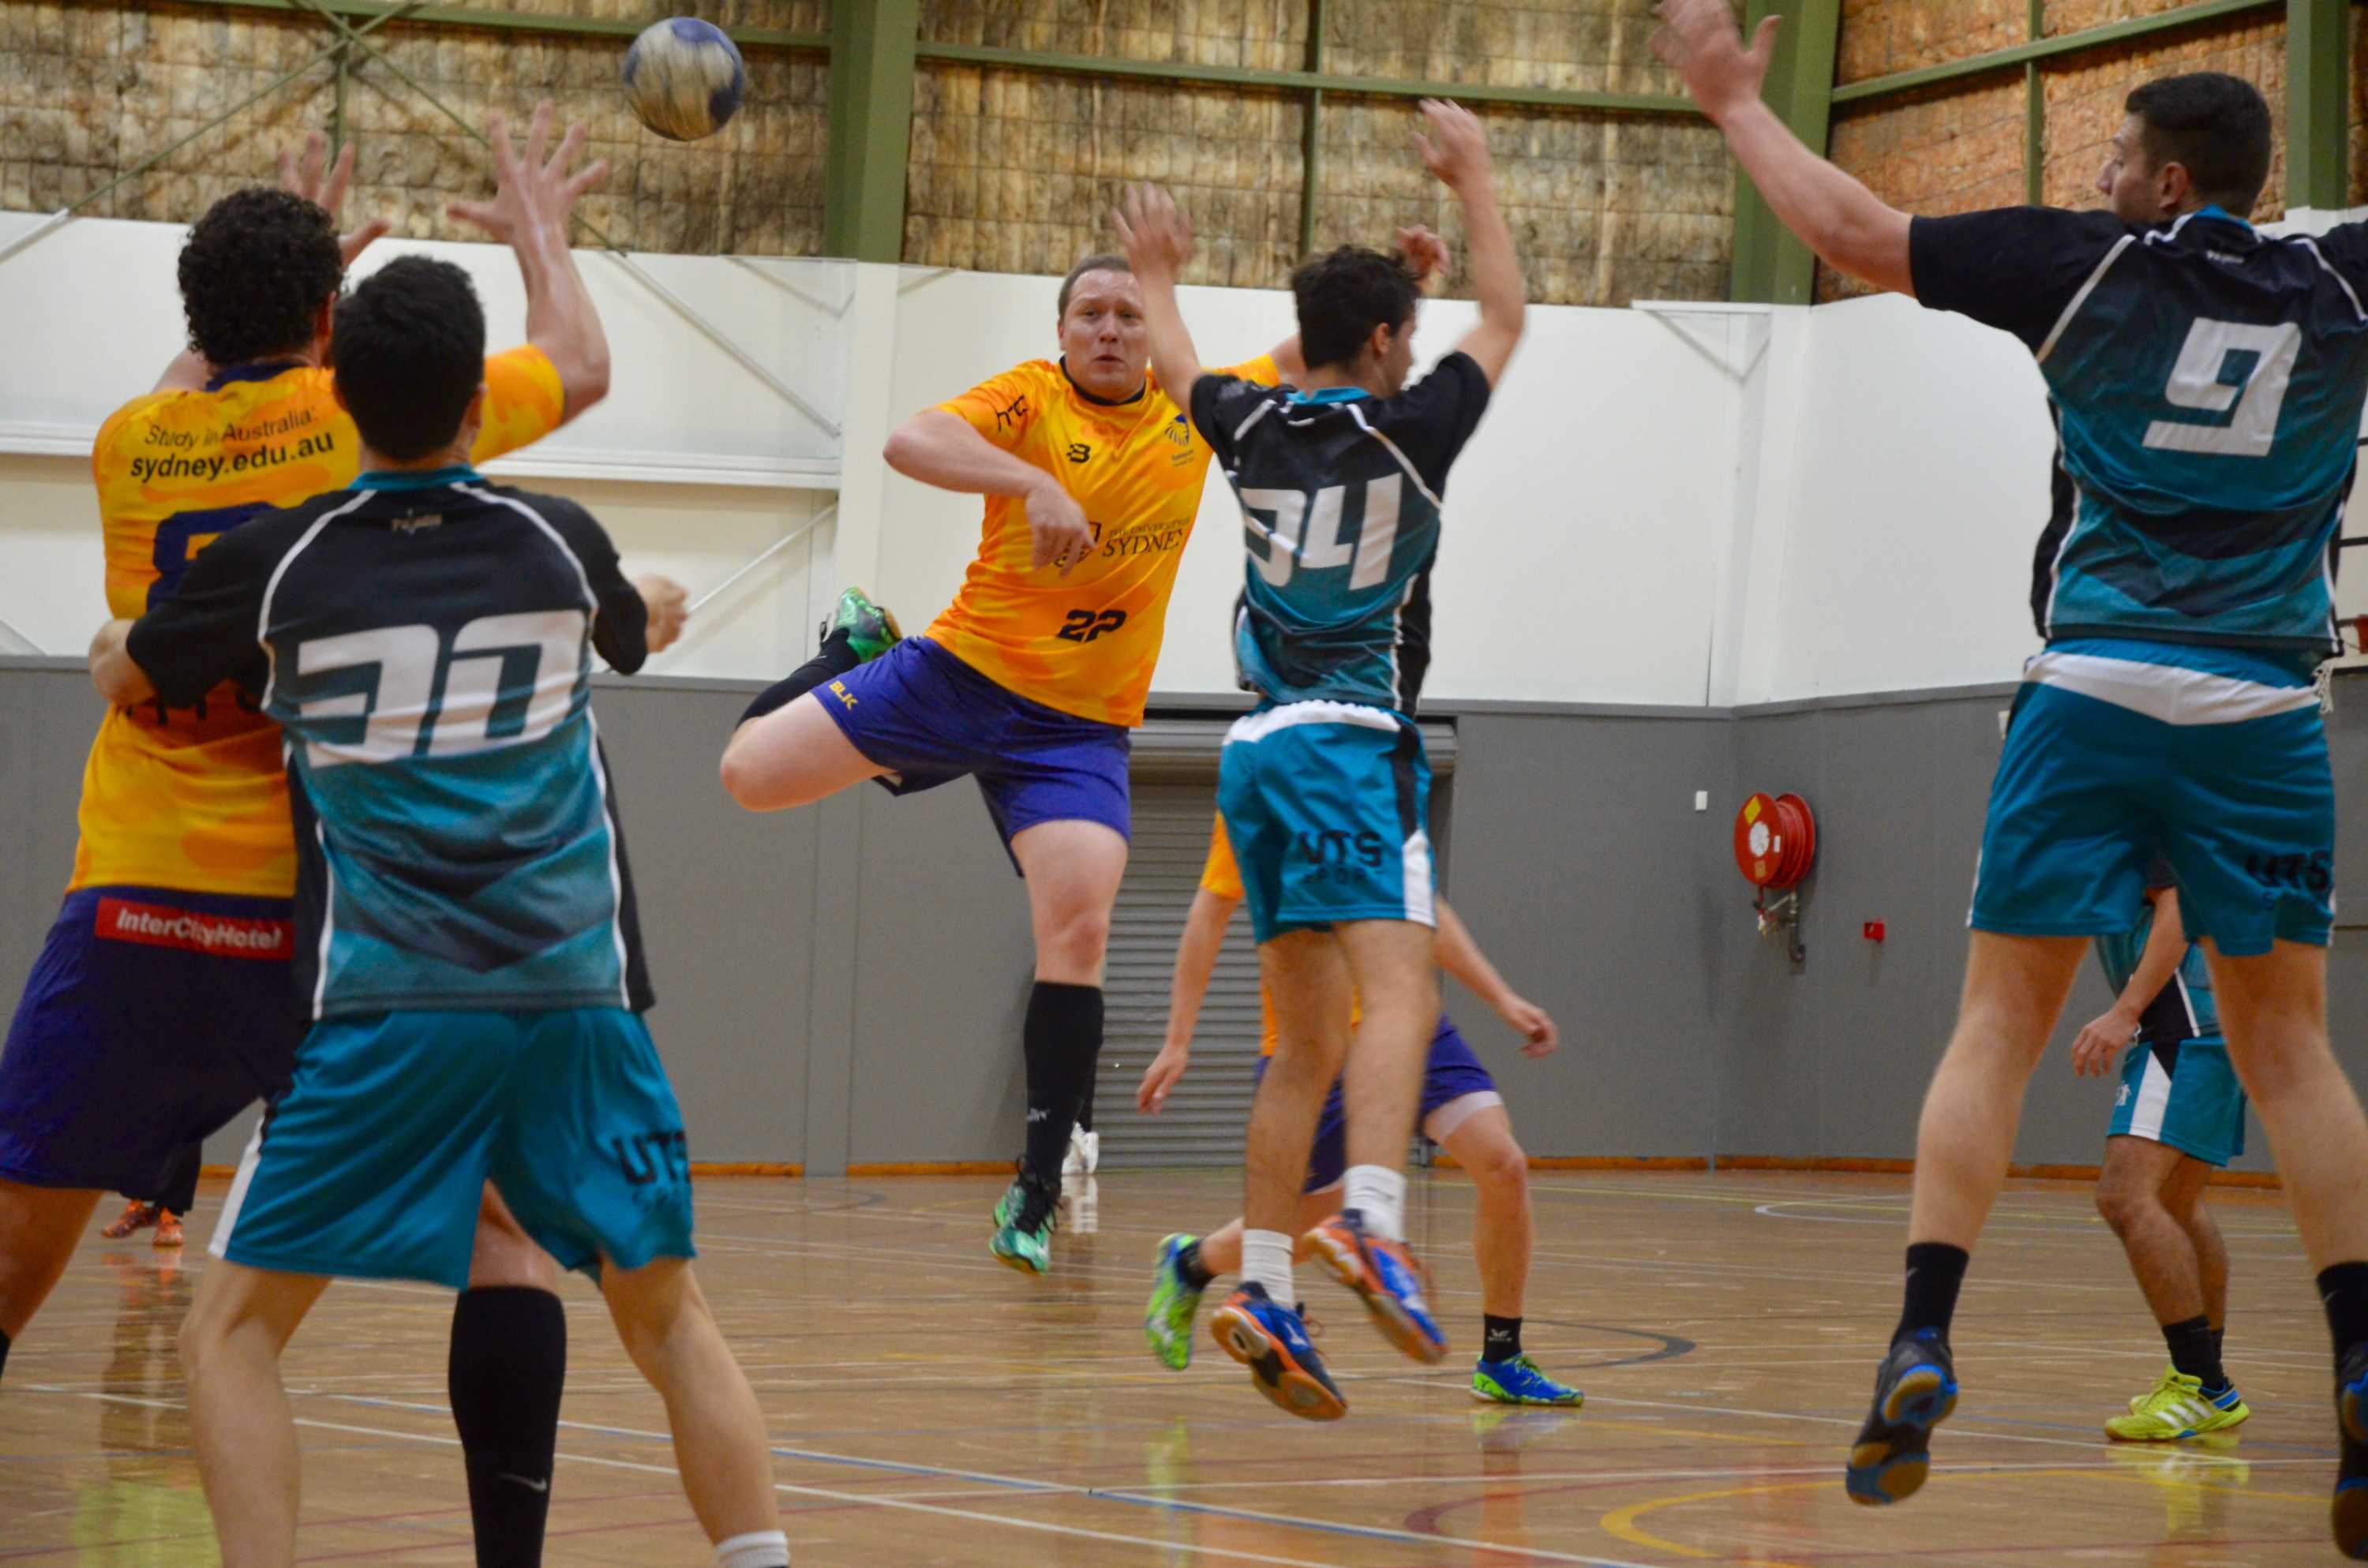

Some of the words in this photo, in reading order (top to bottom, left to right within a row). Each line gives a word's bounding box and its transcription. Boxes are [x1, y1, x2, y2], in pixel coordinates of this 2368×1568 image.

[2141, 316, 2302, 457] 9
[145, 425, 197, 451] Study
[203, 427, 219, 446] in
[220, 406, 319, 443] Australia:
[130, 432, 335, 484] sydney.edu.au
[1240, 472, 1403, 590] 34
[1056, 608, 1128, 643] 22
[297, 609, 586, 769] 30
[829, 680, 859, 711] BLK
[1299, 830, 1382, 867] UTS
[2245, 851, 2329, 891] UTS
[116, 907, 284, 951] InterCityHotel
